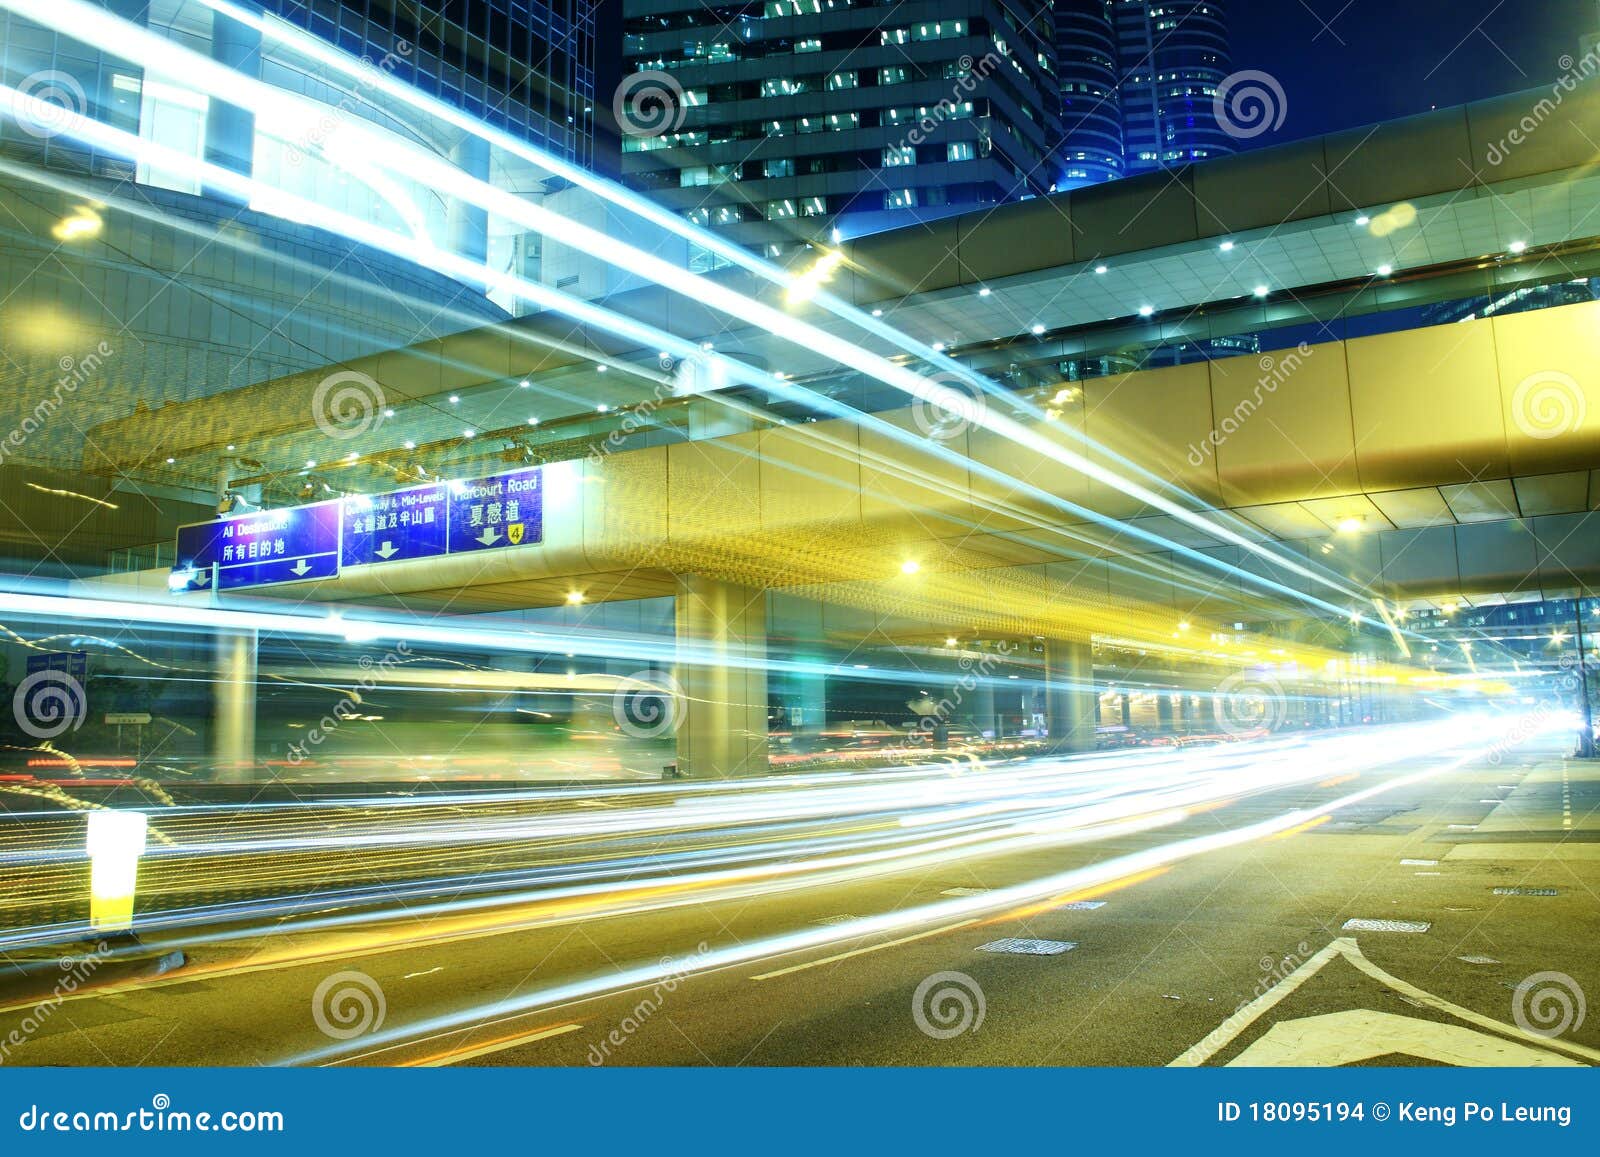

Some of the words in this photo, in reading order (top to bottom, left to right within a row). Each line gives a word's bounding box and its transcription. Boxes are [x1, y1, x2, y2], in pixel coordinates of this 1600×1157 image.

[507, 475, 537, 493] Road
[391, 498, 399, 508] &
[402, 491, 445, 507] Mid-Levels
[222, 525, 234, 538] All
[511, 527, 519, 539] 4
[223, 538, 285, 561] 所有目的地
